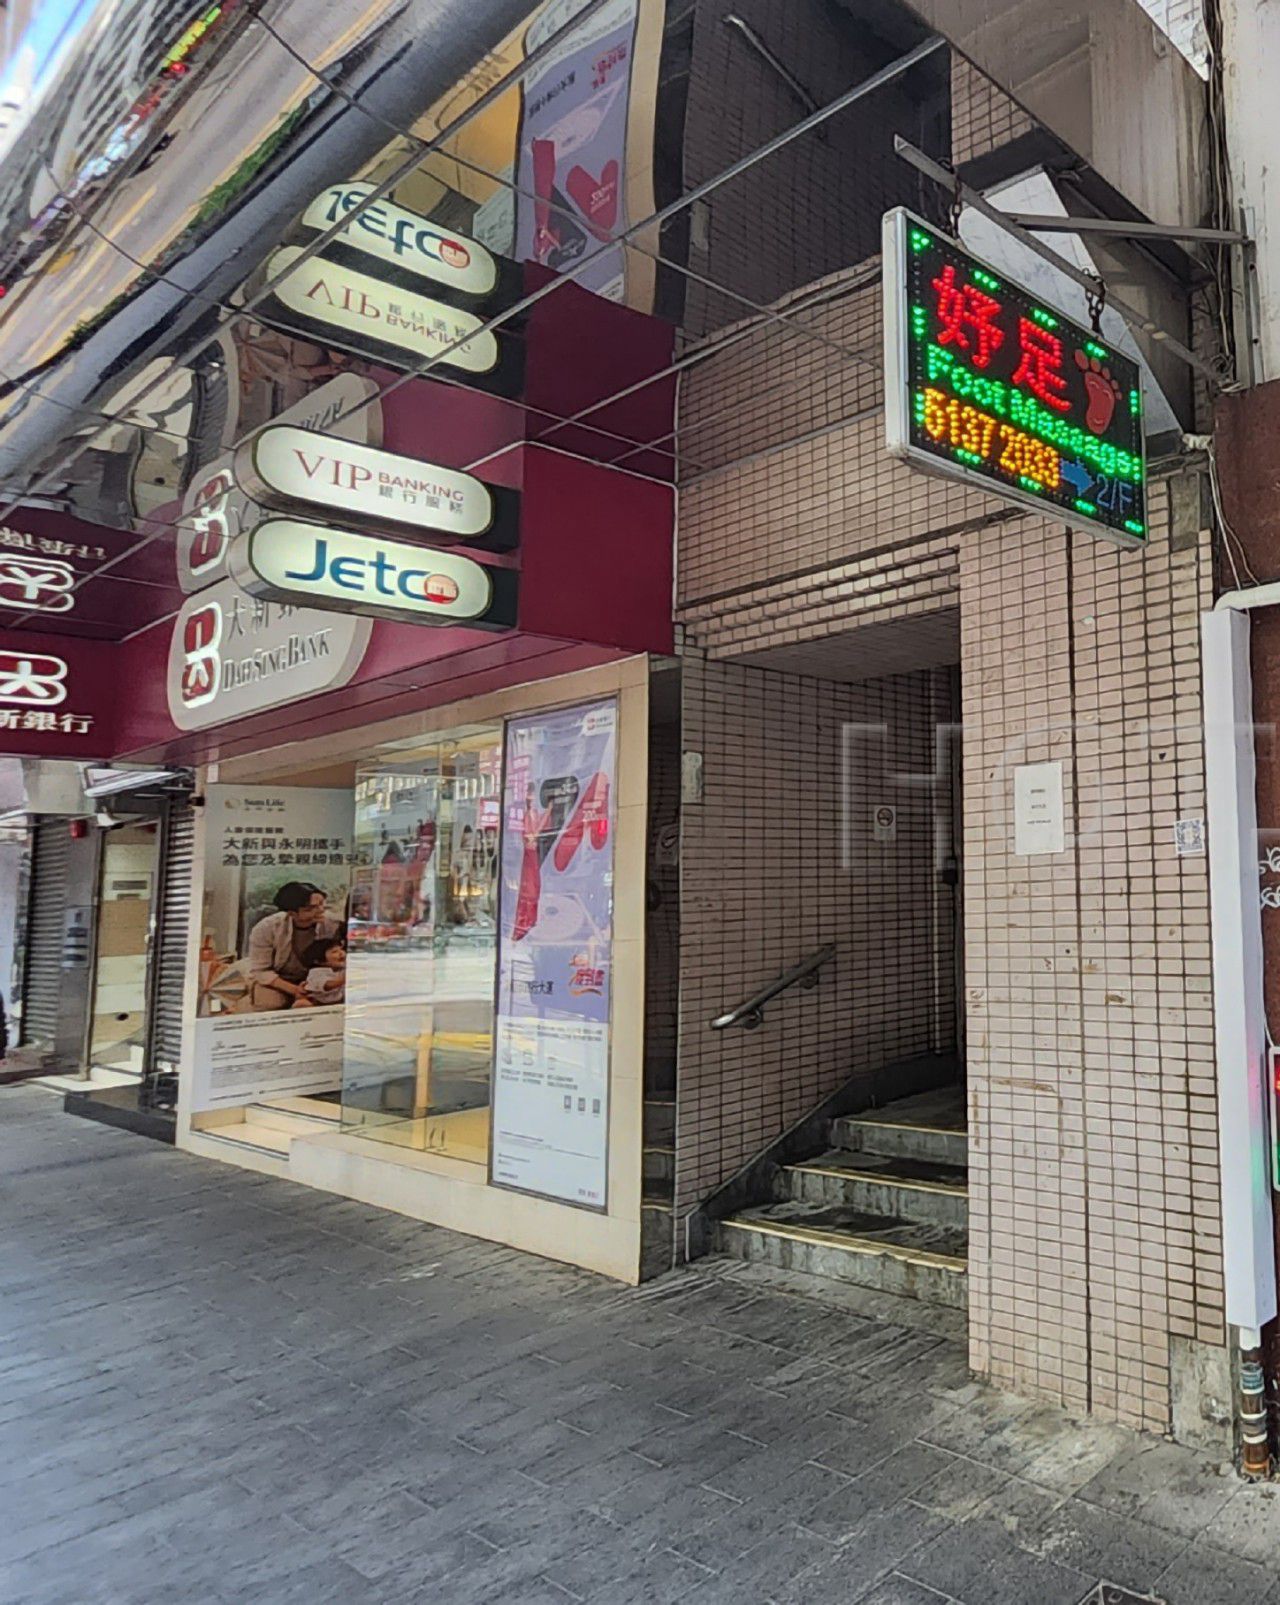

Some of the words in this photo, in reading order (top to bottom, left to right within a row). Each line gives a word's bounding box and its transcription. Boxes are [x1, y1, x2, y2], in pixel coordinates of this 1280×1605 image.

[931, 263, 1073, 413] 好足
[292, 448, 372, 491] VIP
[378, 472, 465, 502] BANKING
[1094, 474, 1133, 515] 2/F
[378, 486, 464, 515] 銀行服務
